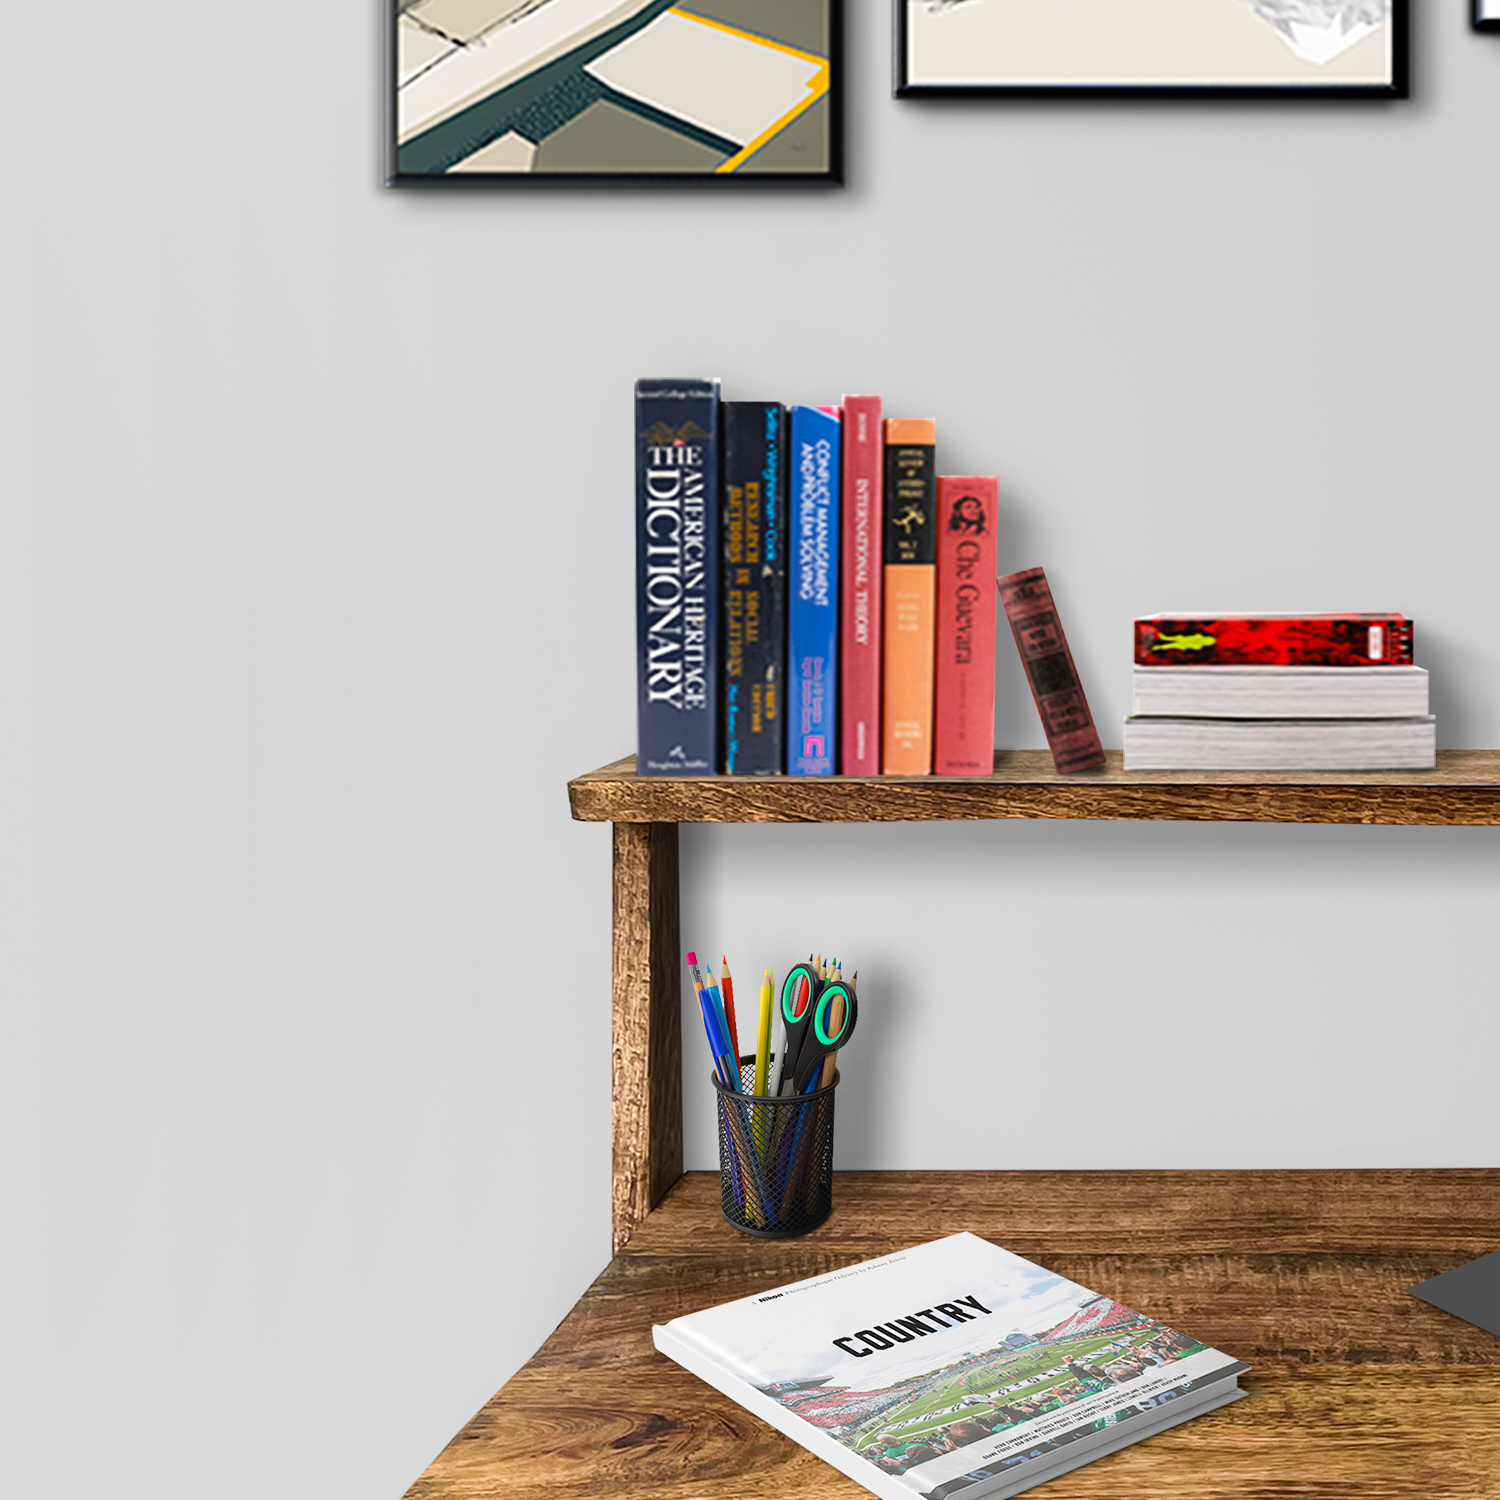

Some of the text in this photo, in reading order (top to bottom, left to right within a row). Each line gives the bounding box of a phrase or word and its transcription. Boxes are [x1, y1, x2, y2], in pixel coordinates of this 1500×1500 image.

[648, 447, 702, 466] THE
[728, 486, 743, 563] METHODS
[765, 529, 778, 562] Cook
[800, 441, 815, 600] AND PROBLEM SOLVING
[815, 439, 831, 606] CONFLICT MANAGEMENT
[855, 479, 869, 645] INTERNATIONAL THEORY
[956, 540, 980, 579] Che
[646, 468, 683, 710] DICTIONARY
[684, 467, 706, 710] AMERICAN HERITAGE
[745, 482, 759, 646] RESEARCH SOCIAL
[728, 590, 743, 677] RELATIONS
[956, 583, 980, 665] Guevara
[758, 1292, 784, 1303] Nikon
[832, 1294, 993, 1358] COUNTRY
